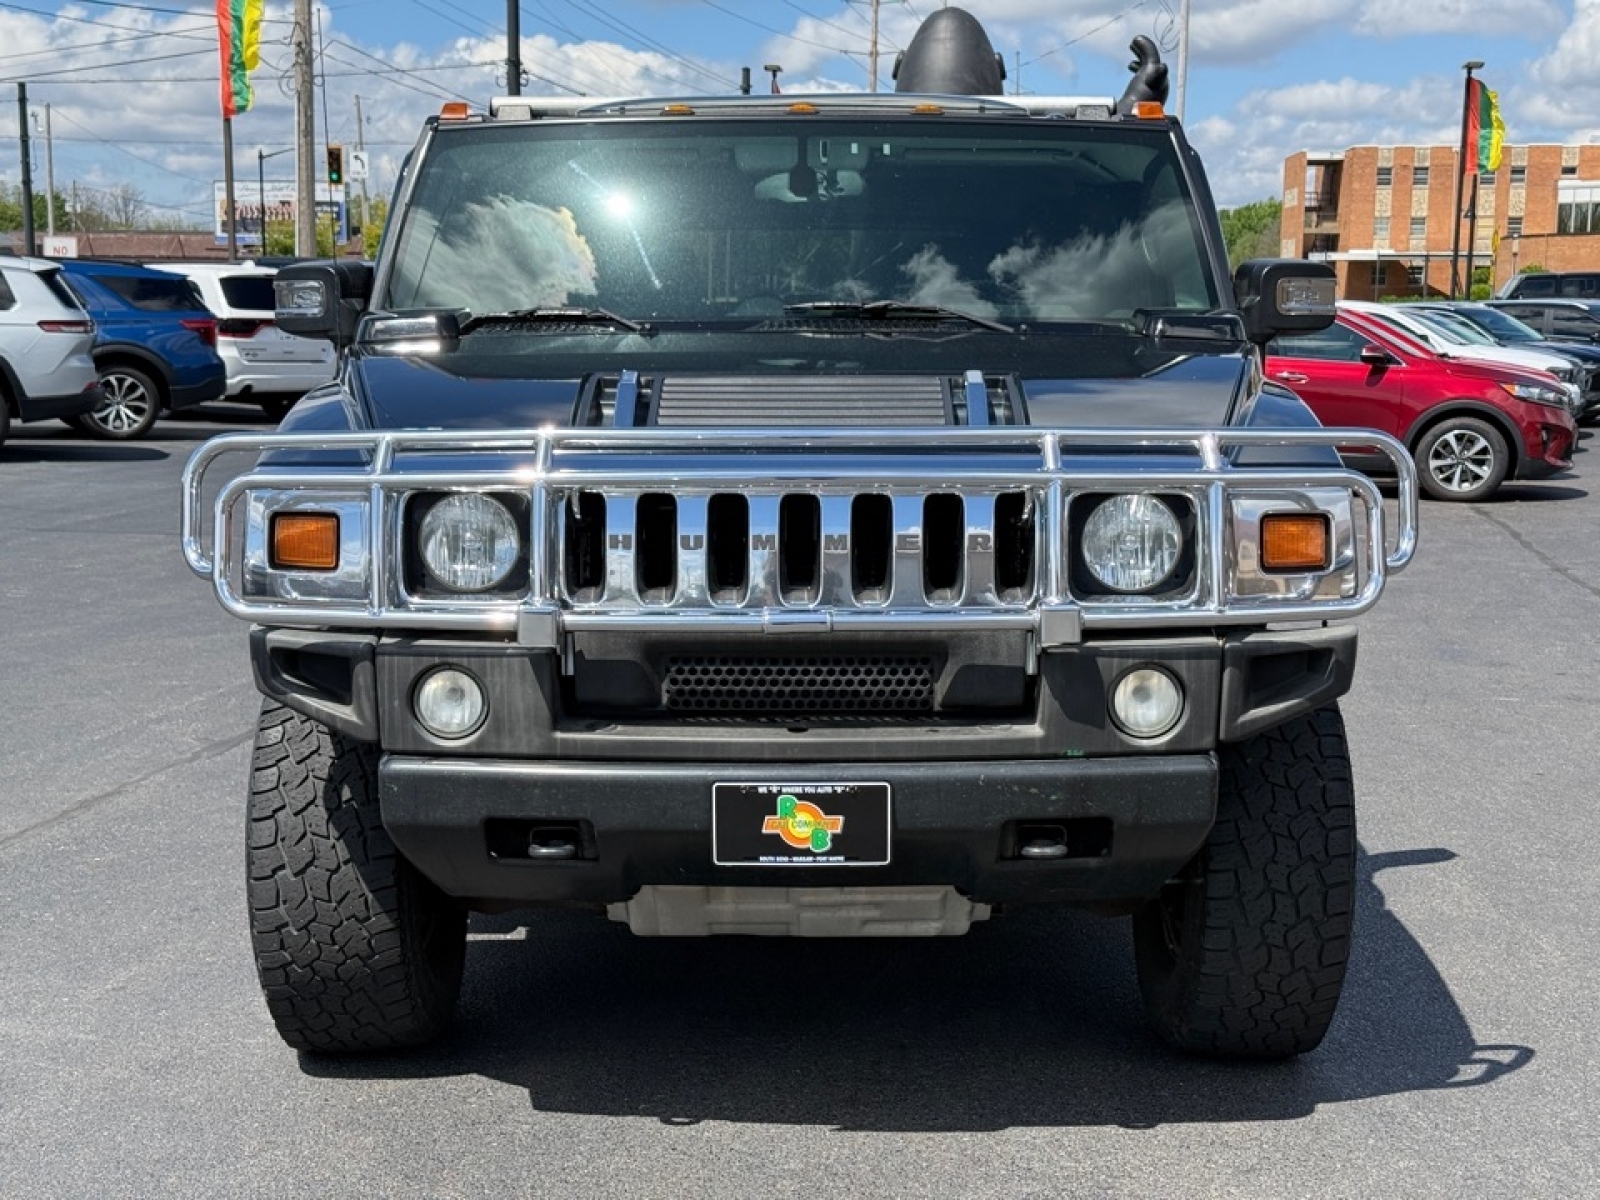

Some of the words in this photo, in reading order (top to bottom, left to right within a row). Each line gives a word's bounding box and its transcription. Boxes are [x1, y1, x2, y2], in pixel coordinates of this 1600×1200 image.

[53, 246, 68, 256] NO
[608, 533, 993, 552] HUMMER
[778, 795, 798, 818] R
[810, 828, 831, 852] B
